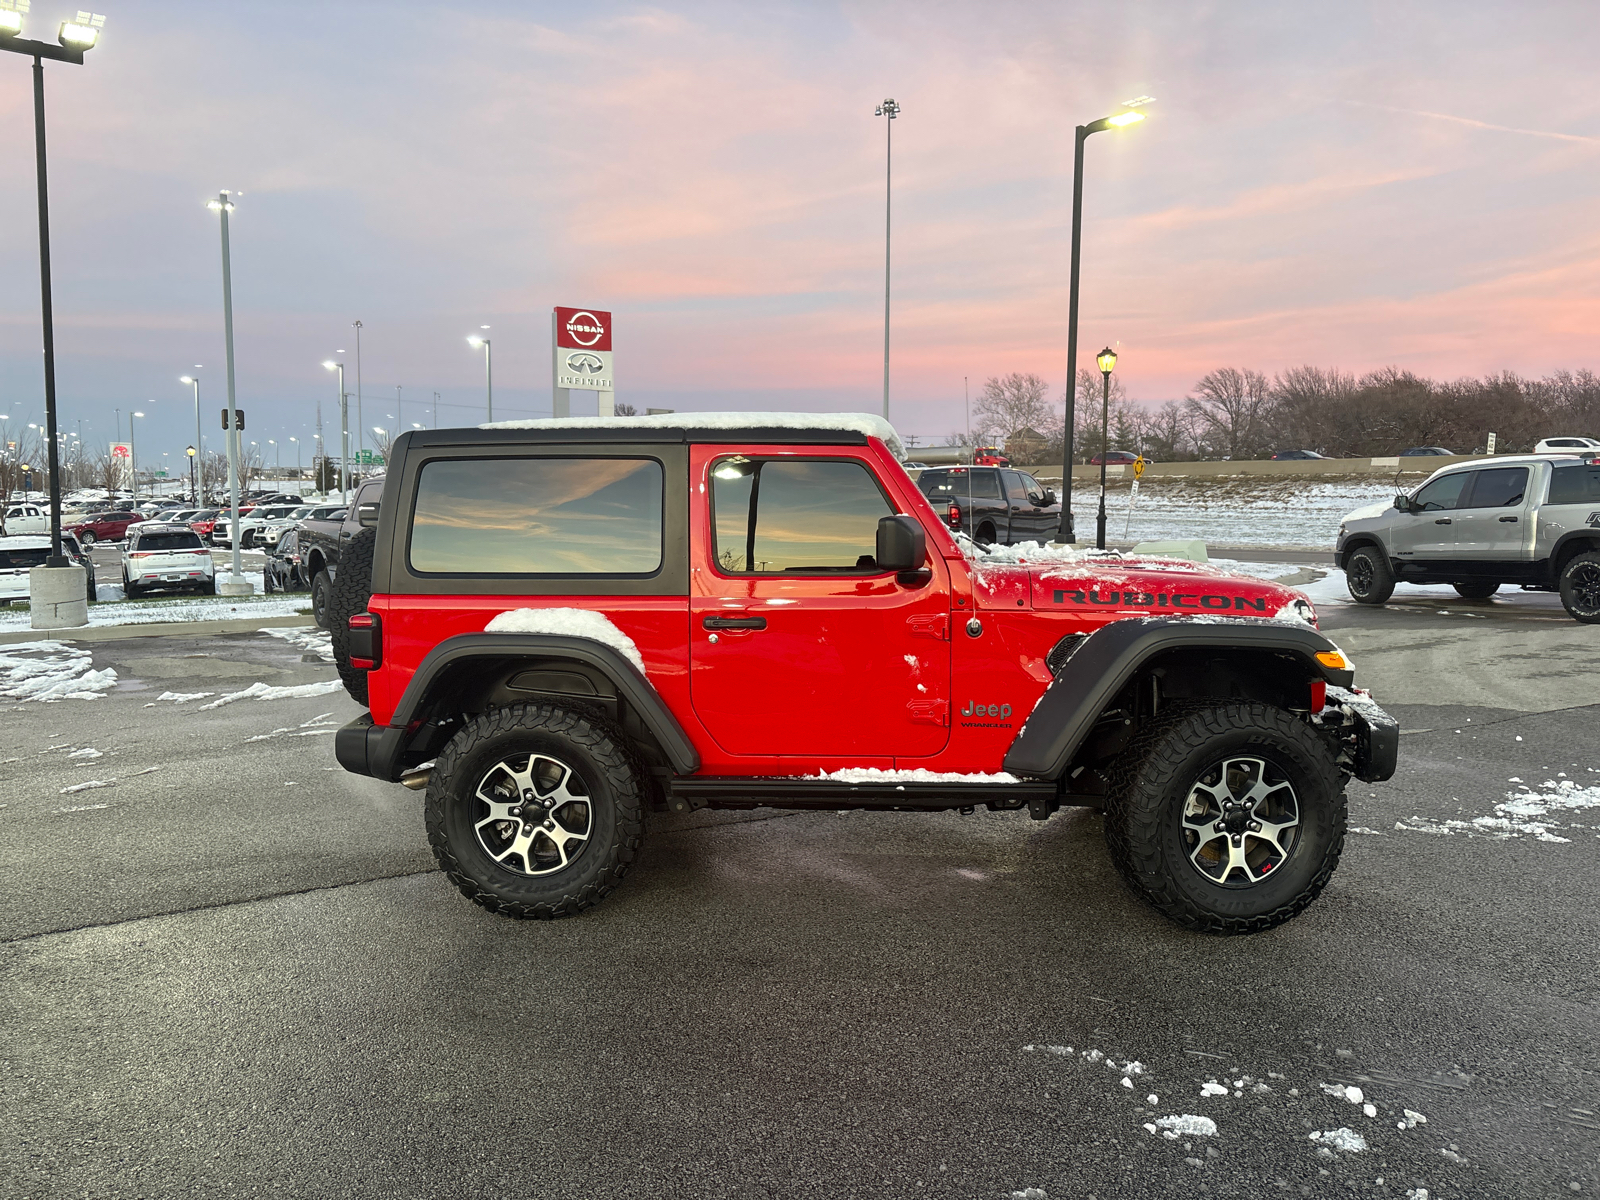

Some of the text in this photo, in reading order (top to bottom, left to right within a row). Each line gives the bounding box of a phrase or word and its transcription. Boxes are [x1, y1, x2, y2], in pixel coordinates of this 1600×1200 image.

[566, 323, 604, 334] NISSAN
[559, 376, 611, 387] INFINITI
[1053, 589, 1266, 611] RUBICON
[961, 700, 1012, 720] Jeep
